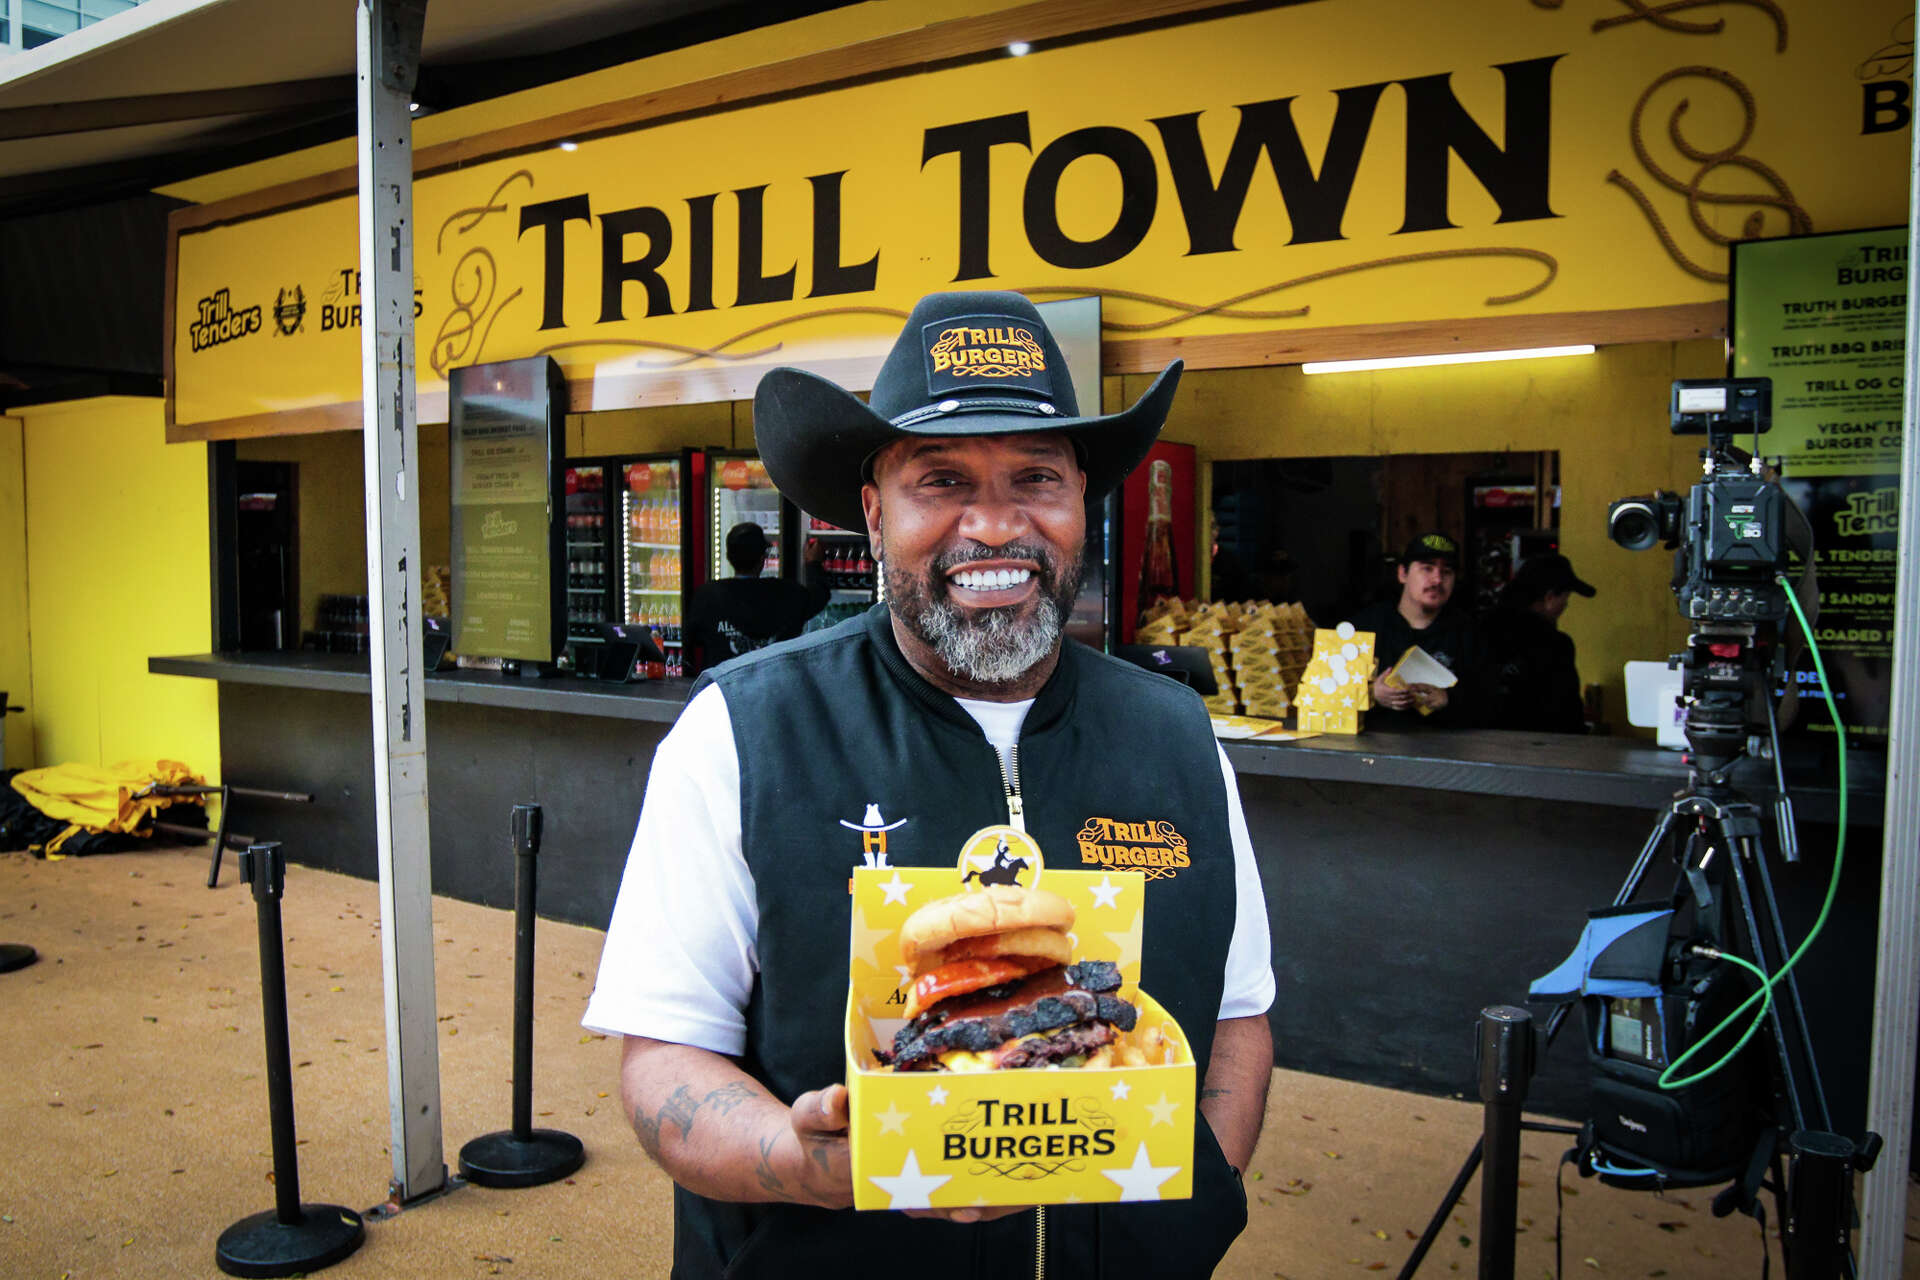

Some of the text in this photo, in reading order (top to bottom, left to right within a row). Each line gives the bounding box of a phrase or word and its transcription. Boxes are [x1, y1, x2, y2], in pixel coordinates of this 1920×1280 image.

[518, 53, 1569, 331] TRILL TOWN
[1838, 266, 1904, 286] BURG
[198, 287, 229, 325] Trill
[1782, 301, 1836, 314] TRUTH
[190, 305, 261, 352] Tenders
[952, 327, 1022, 346] TRILL
[934, 348, 1046, 372] BURGERS
[1772, 343, 1825, 357] TRUTH
[1830, 341, 1865, 354] BBQ
[1805, 379, 1849, 392] TRILL
[1855, 378, 1882, 389] OG
[1818, 421, 1877, 434] VEGAN
[1806, 437, 1873, 450] BURGER
[1814, 629, 1882, 642] LOADED
[1097, 818, 1163, 843] TRILL
[1080, 841, 1191, 868] BURGERS
[978, 1098, 1078, 1127] TRILL
[943, 1129, 1116, 1161] BURGERS
